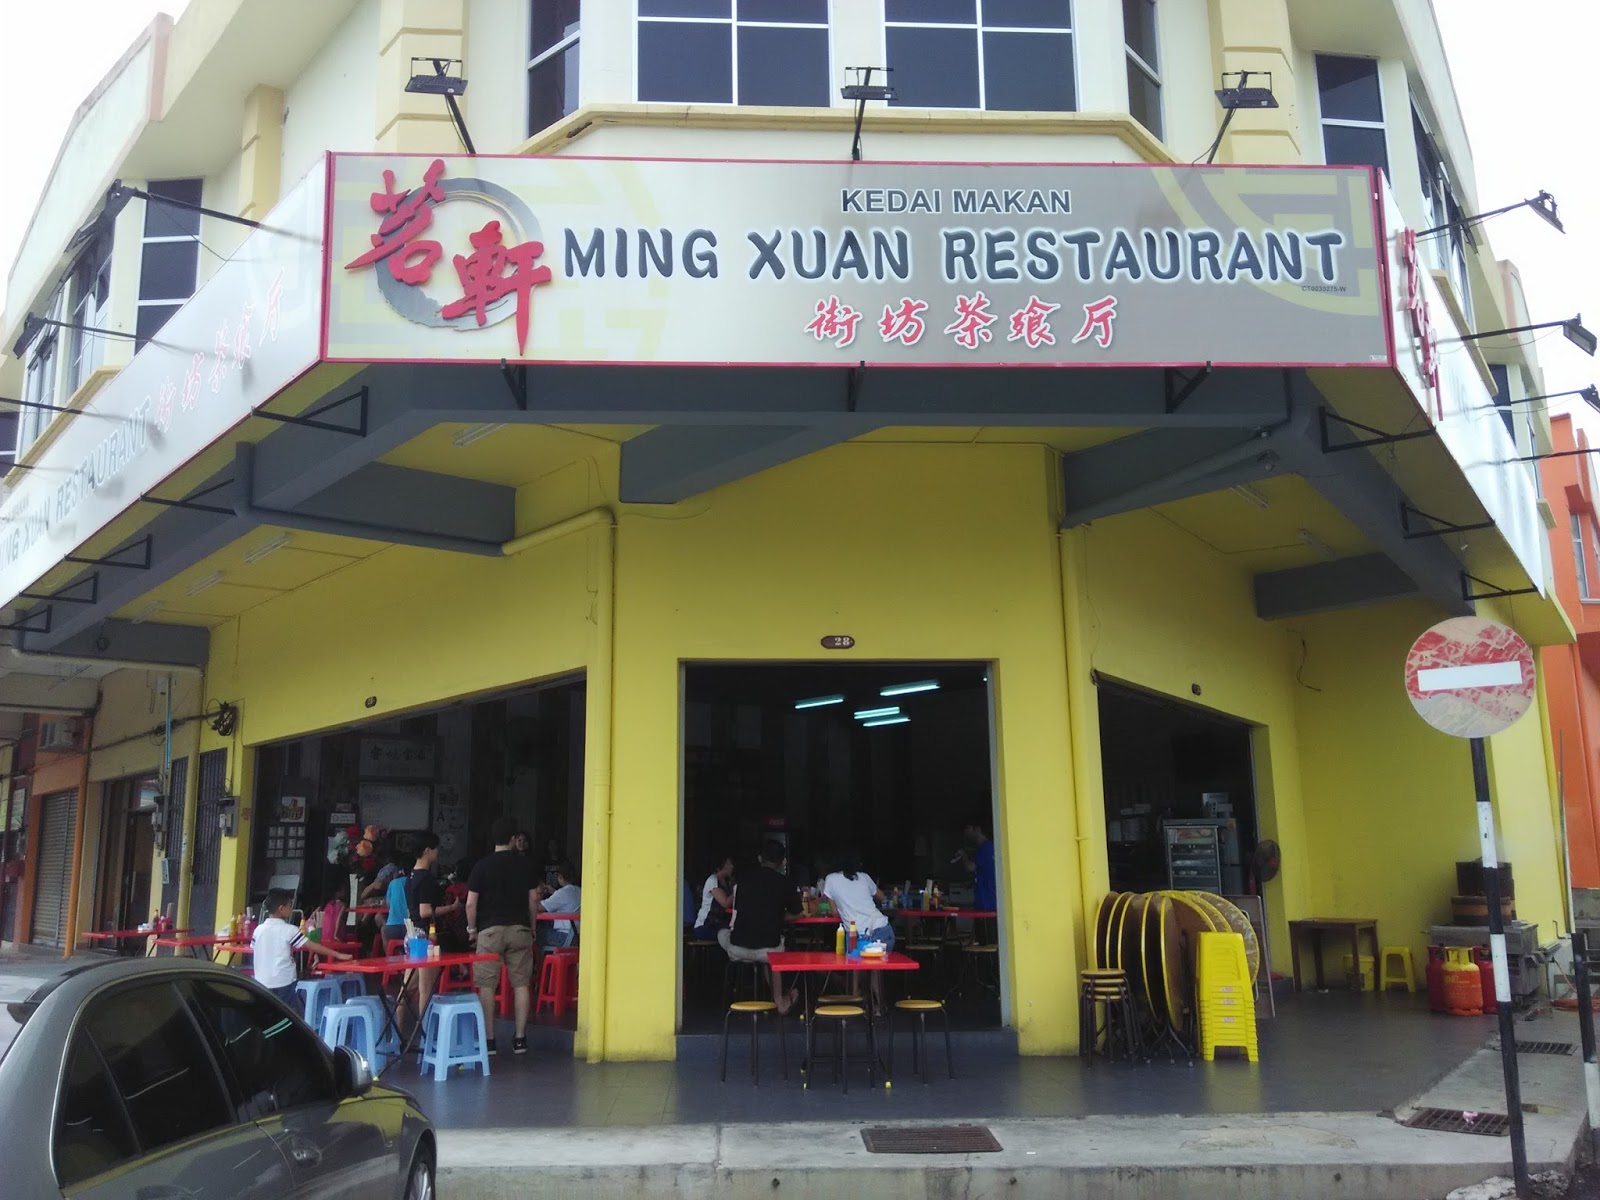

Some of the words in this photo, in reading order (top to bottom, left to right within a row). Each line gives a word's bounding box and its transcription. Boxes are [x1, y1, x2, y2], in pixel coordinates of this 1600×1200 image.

[842, 188, 942, 214] KEDAI
[953, 189, 1071, 215] MAKAN
[564, 226, 719, 280] MING
[747, 228, 910, 283] XUAN
[943, 229, 1343, 284] RESTAURANT
[56, 395, 152, 523] RESTAURANT
[834, 636, 850, 646] 28
